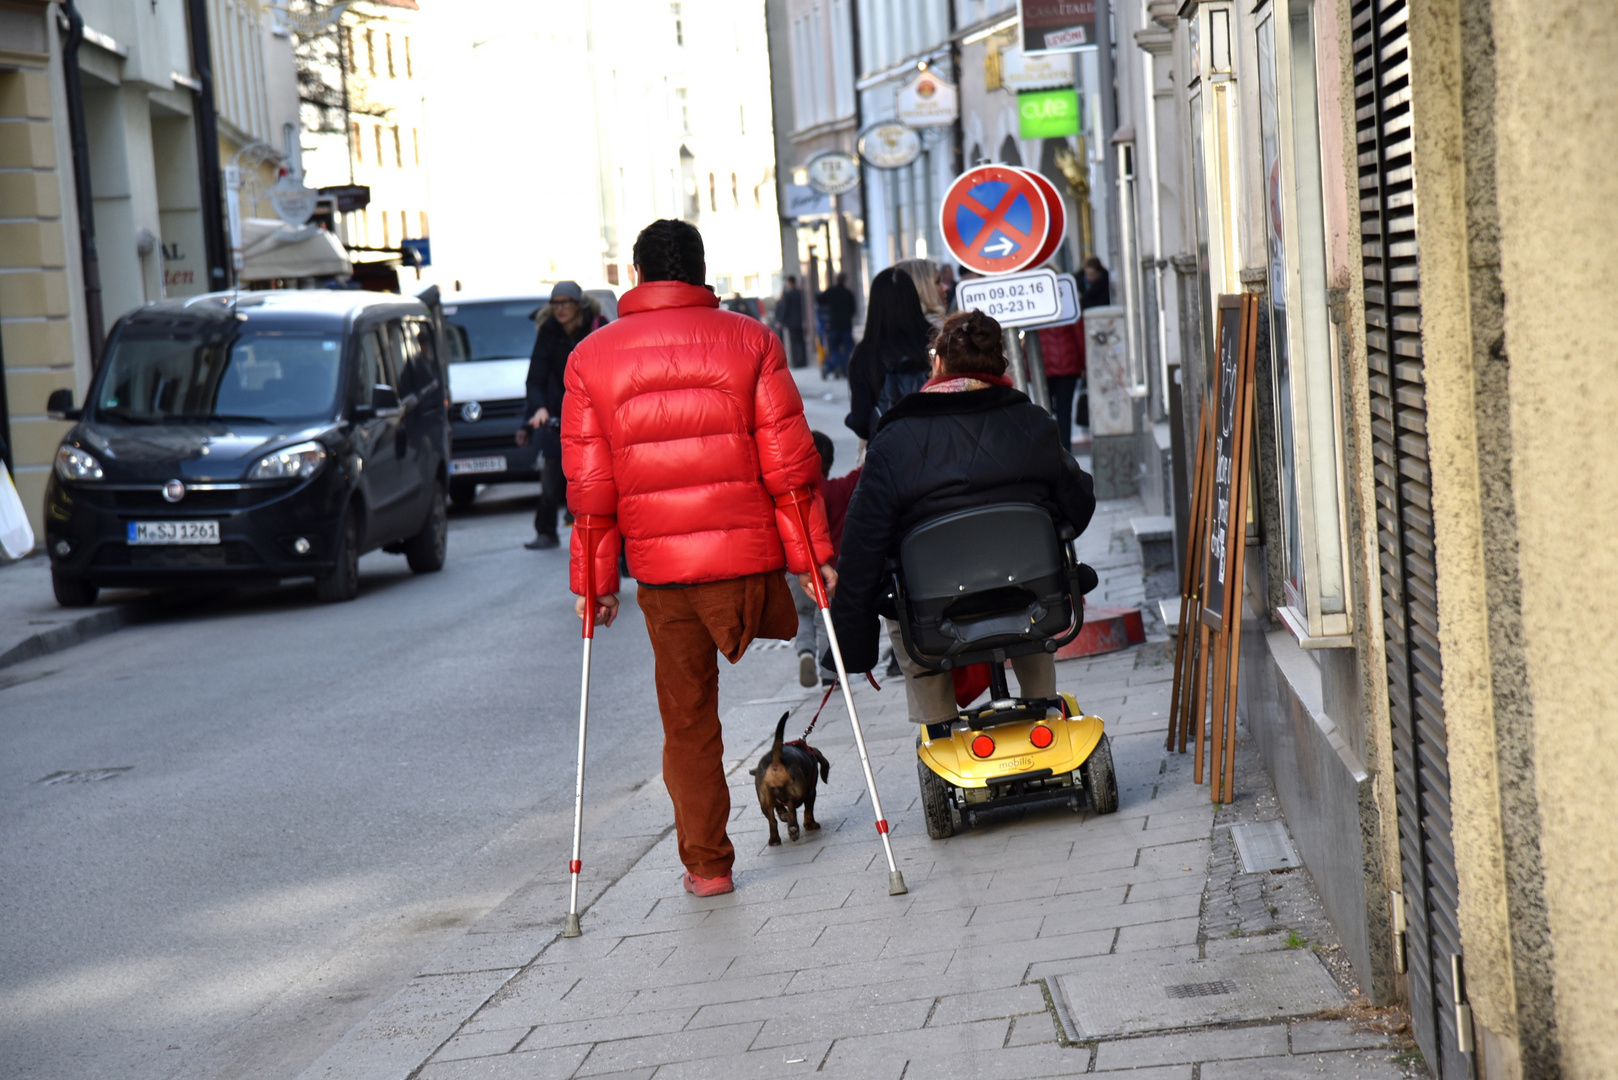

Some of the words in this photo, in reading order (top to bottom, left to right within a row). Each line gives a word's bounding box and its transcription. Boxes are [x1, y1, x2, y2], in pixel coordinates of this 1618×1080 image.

[1046, 30, 1083, 46] LEVONI
[1021, 97, 1068, 119] cute
[966, 291, 986, 303] am
[989, 282, 1044, 300] 09.02.16
[989, 301, 1024, 315] 03-23
[1027, 299, 1036, 311] h
